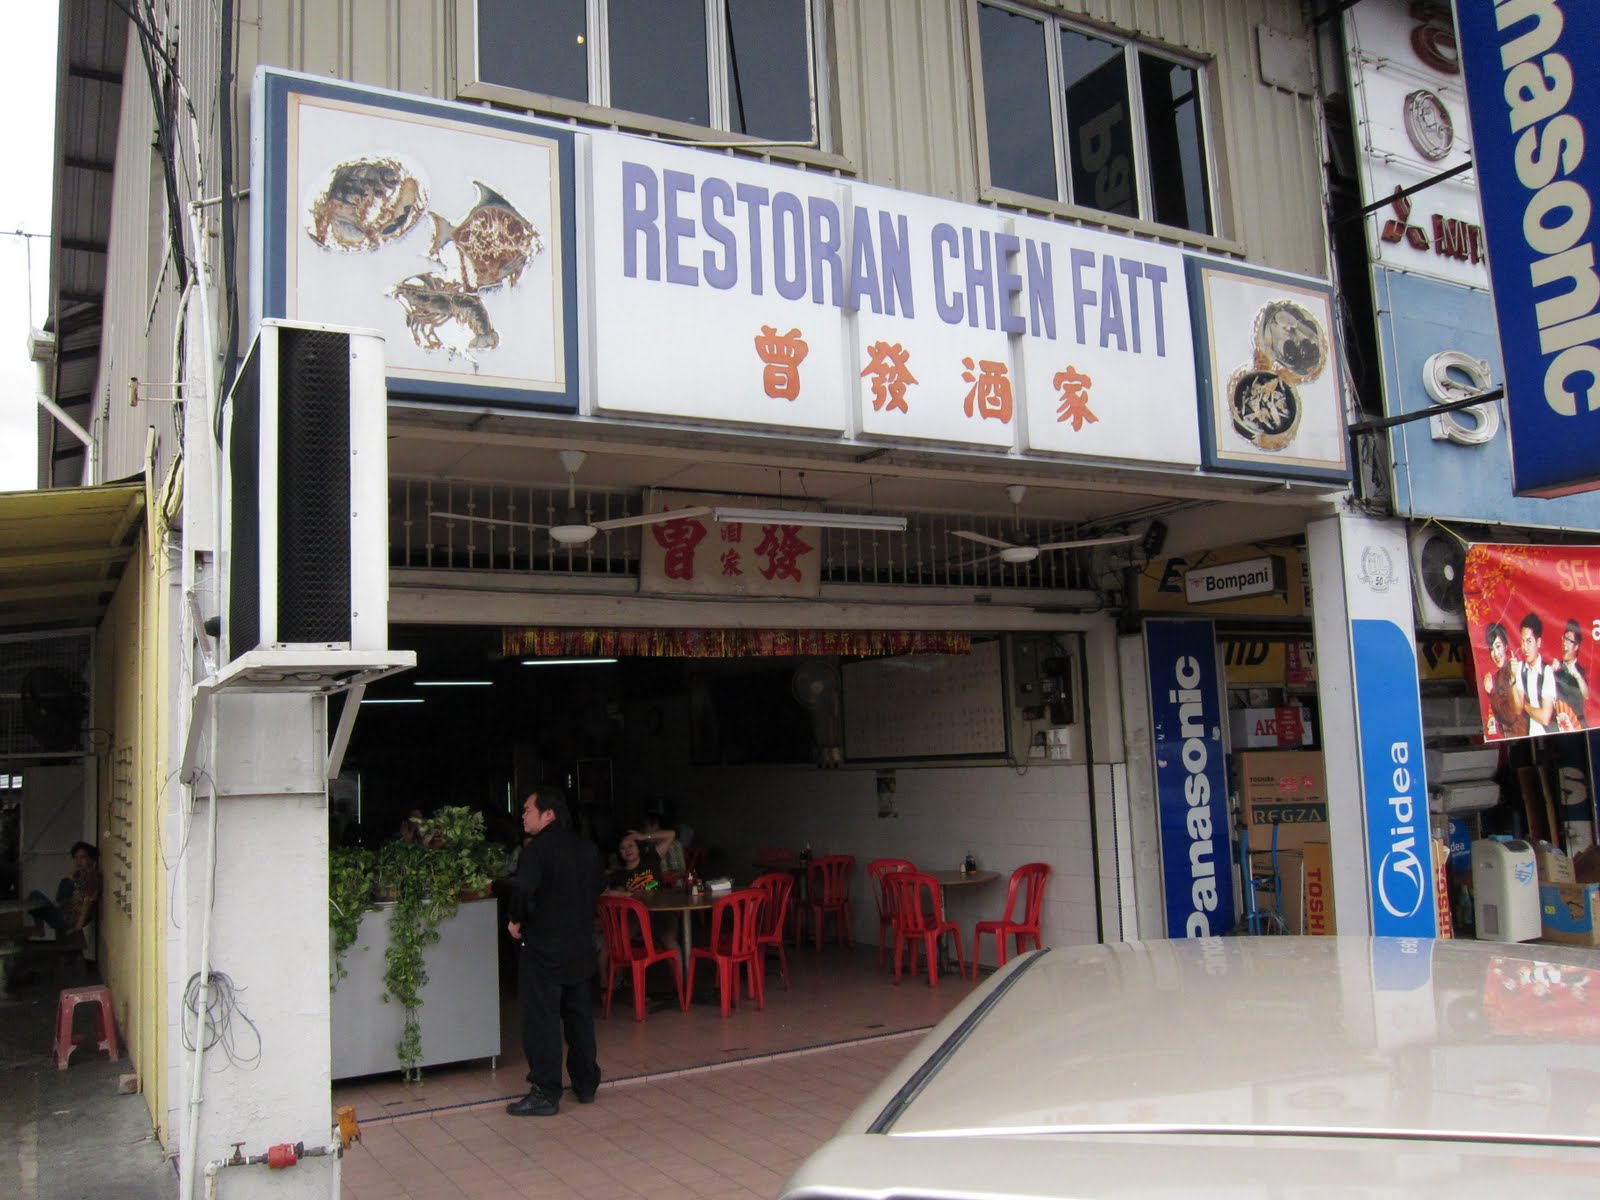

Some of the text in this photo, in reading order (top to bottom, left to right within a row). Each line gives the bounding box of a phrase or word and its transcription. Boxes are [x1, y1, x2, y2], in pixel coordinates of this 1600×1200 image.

[622, 161, 1168, 358] RESTORAN CHEN FATT
[754, 324, 1099, 432] 曾發酒家
[1206, 568, 1269, 592] Bompani
[1169, 655, 1218, 938] Panasonic
[1254, 809, 1321, 823] REGZA
[1386, 741, 1418, 890] Midea
